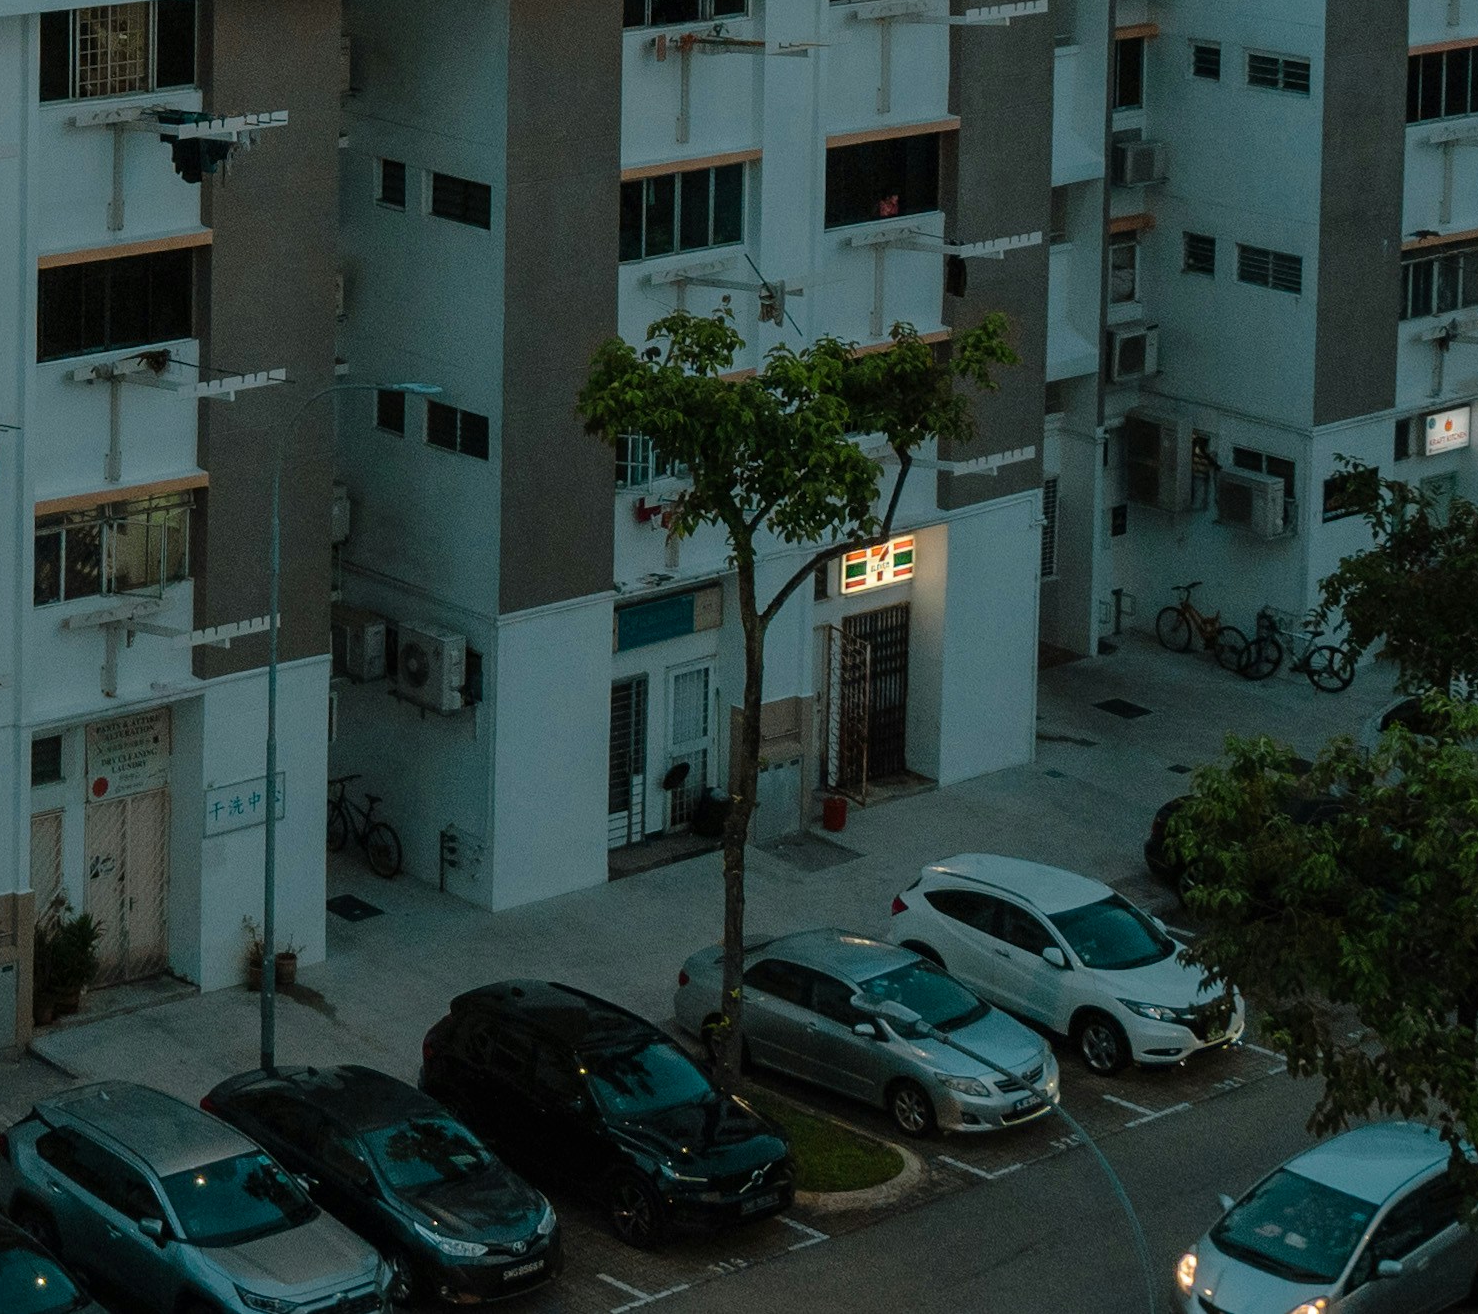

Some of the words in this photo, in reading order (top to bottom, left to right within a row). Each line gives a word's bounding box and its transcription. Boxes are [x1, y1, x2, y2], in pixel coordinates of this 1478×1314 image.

[870, 545, 890, 582] 7
[96, 723, 121, 734] PANTS
[105, 724, 155, 741] ALTERATION
[101, 757, 116, 767] DRY
[118, 748, 158, 764] CLEANING
[111, 760, 147, 774] LAUNDRY
